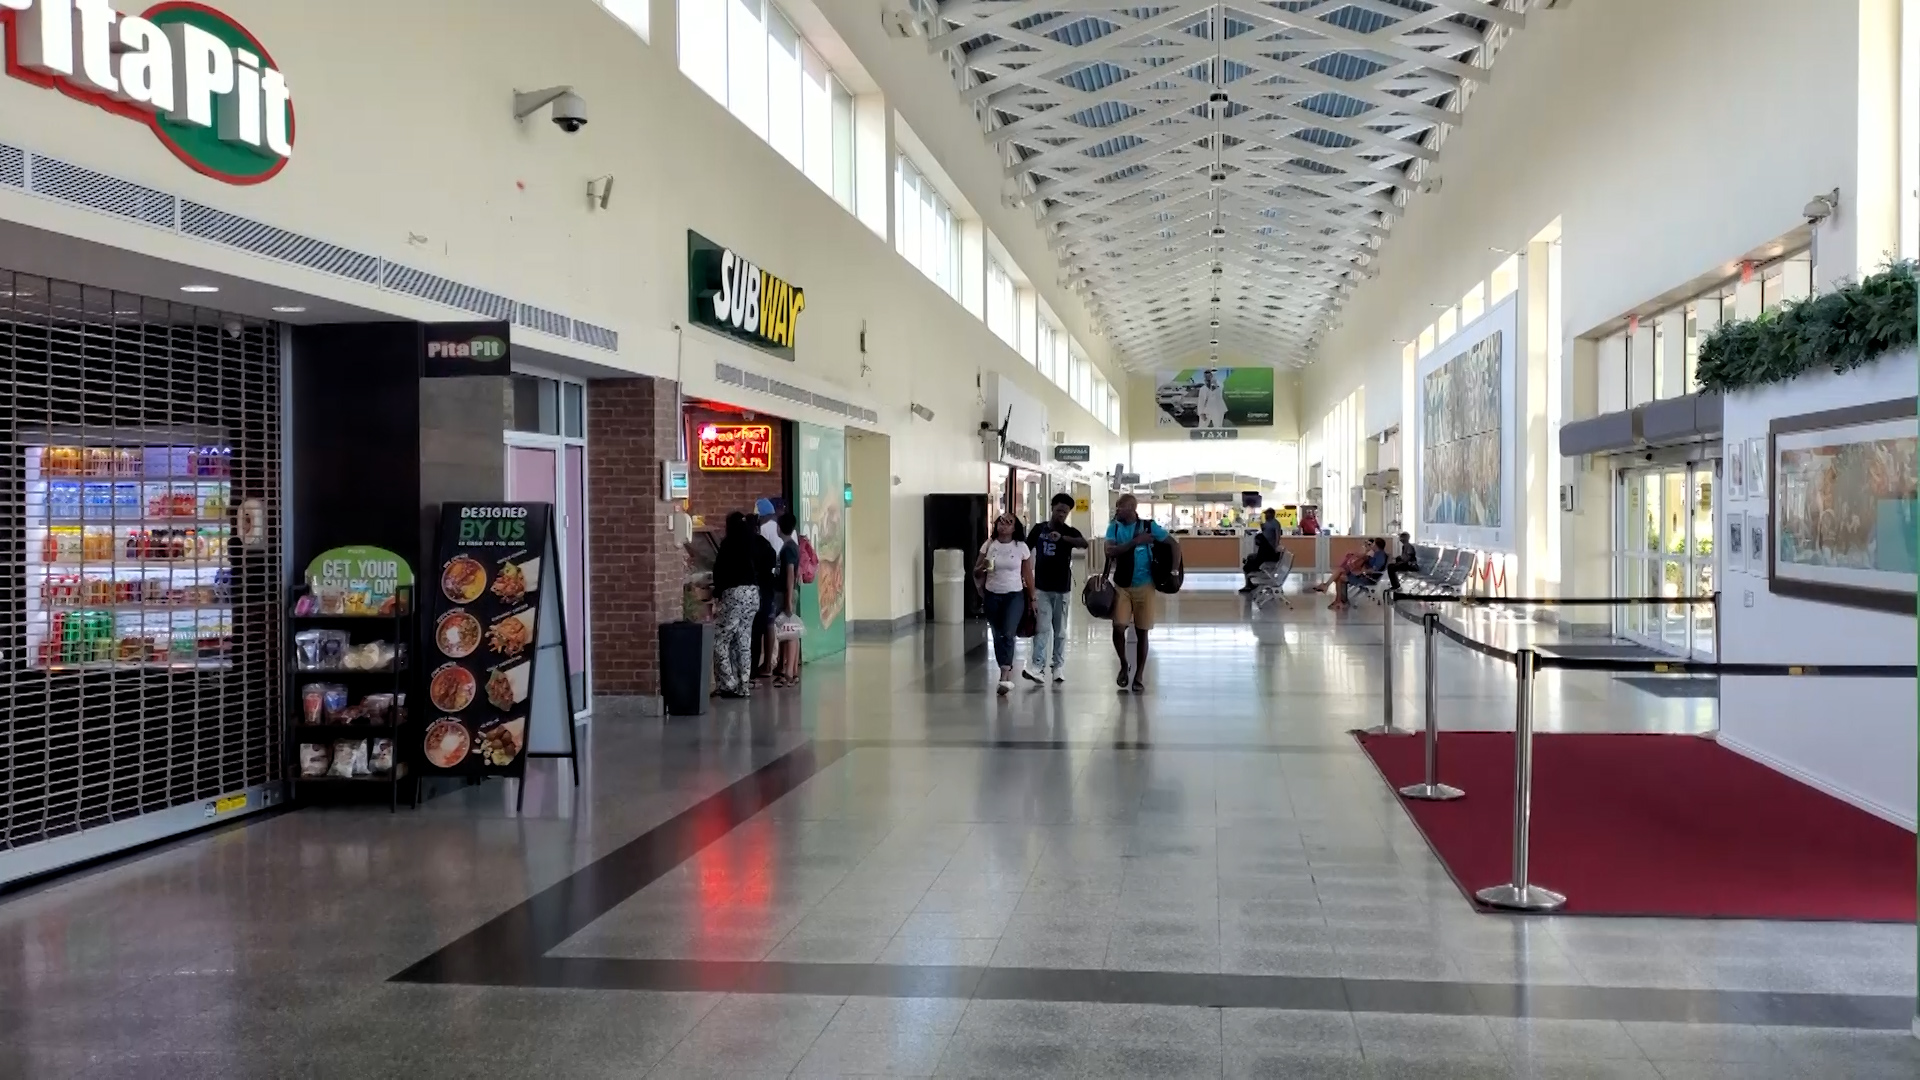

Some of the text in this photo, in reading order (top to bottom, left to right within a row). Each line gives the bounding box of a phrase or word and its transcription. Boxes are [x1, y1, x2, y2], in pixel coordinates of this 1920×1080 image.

[713, 247, 805, 348] SUBWAY
[1200, 430, 1229, 438] TAXI
[750, 441, 769, 454] Till
[700, 452, 734, 466] 11:00
[802, 471, 820, 496] GOOD
[460, 507, 528, 518] DESIGNED
[802, 497, 811, 522] TO
[459, 519, 526, 540] BY US
[1043, 541, 1057, 556] 12
[322, 559, 398, 578] GET YOUR
